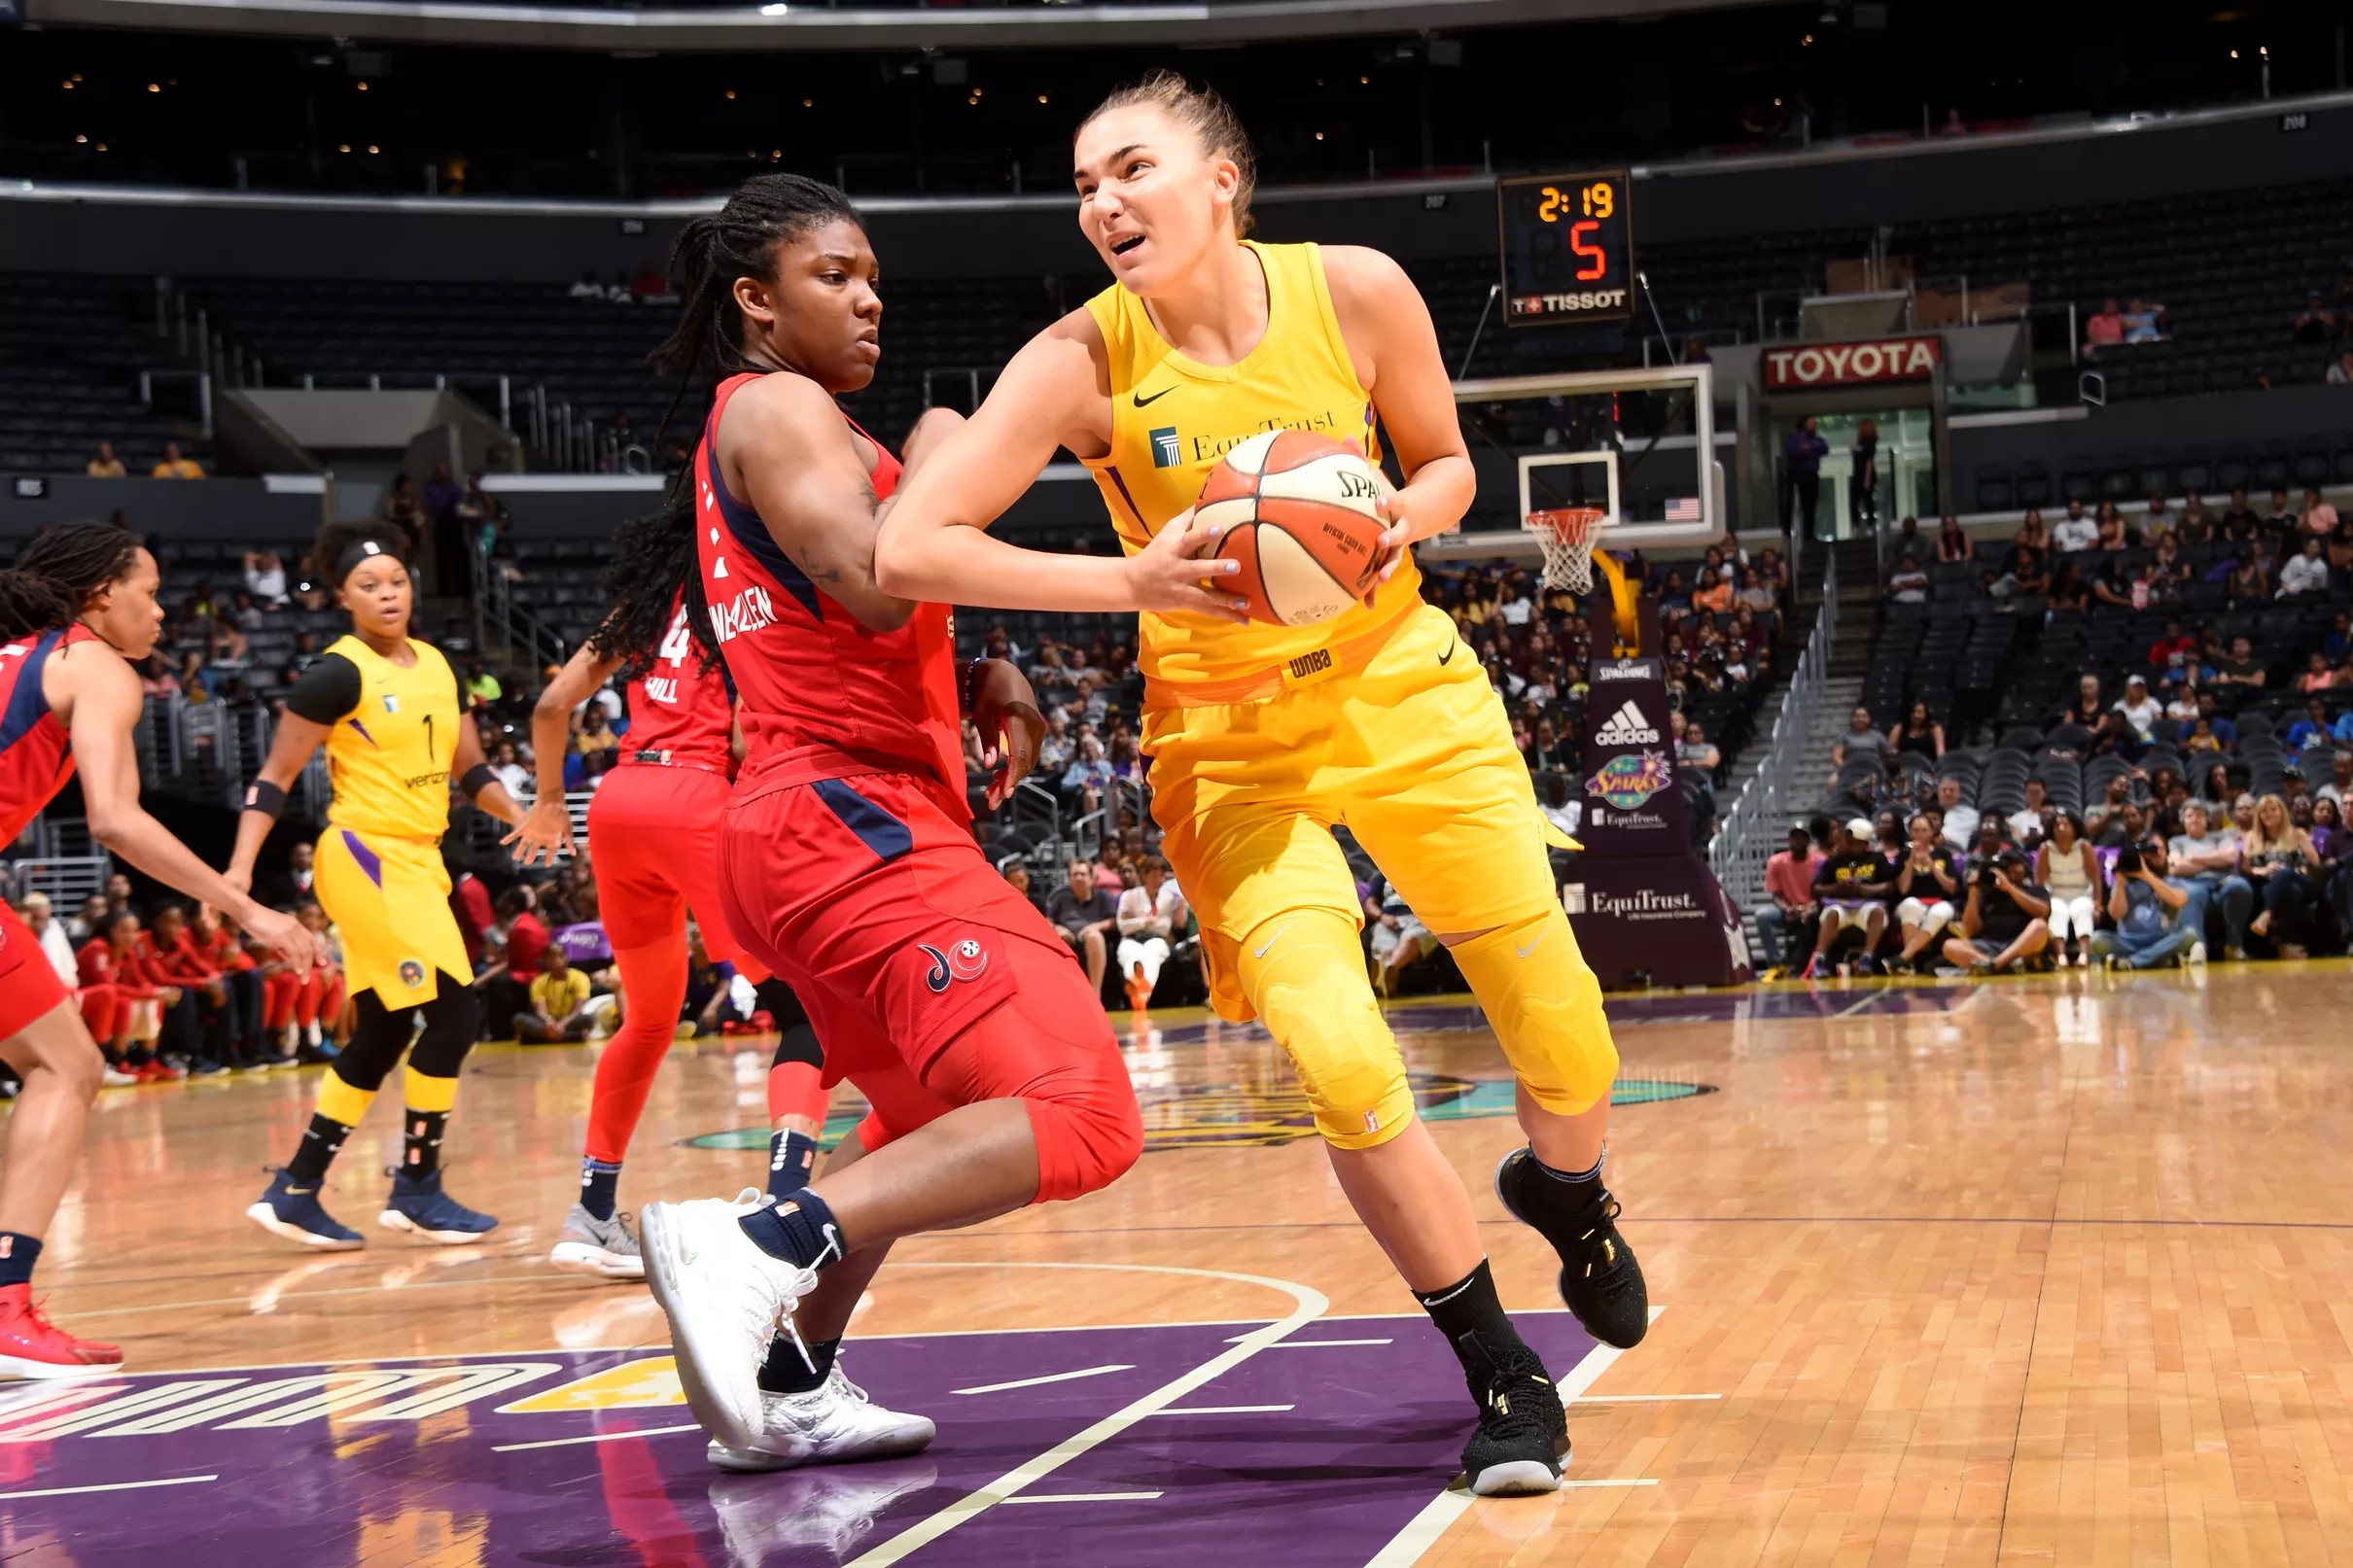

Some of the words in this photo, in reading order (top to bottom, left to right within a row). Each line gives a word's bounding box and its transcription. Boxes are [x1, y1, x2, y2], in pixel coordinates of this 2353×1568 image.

[1539, 183, 1614, 223] 2:19
[1570, 221, 1606, 281] 5
[1543, 289, 1627, 312] TISSOT
[1768, 341, 1935, 385] TOYOTA
[660, 604, 690, 669] 4
[1288, 648, 1332, 679] WNBA
[1599, 664, 1651, 680] SPALDING
[422, 714, 435, 764] 1
[1595, 728, 1660, 746] adidas
